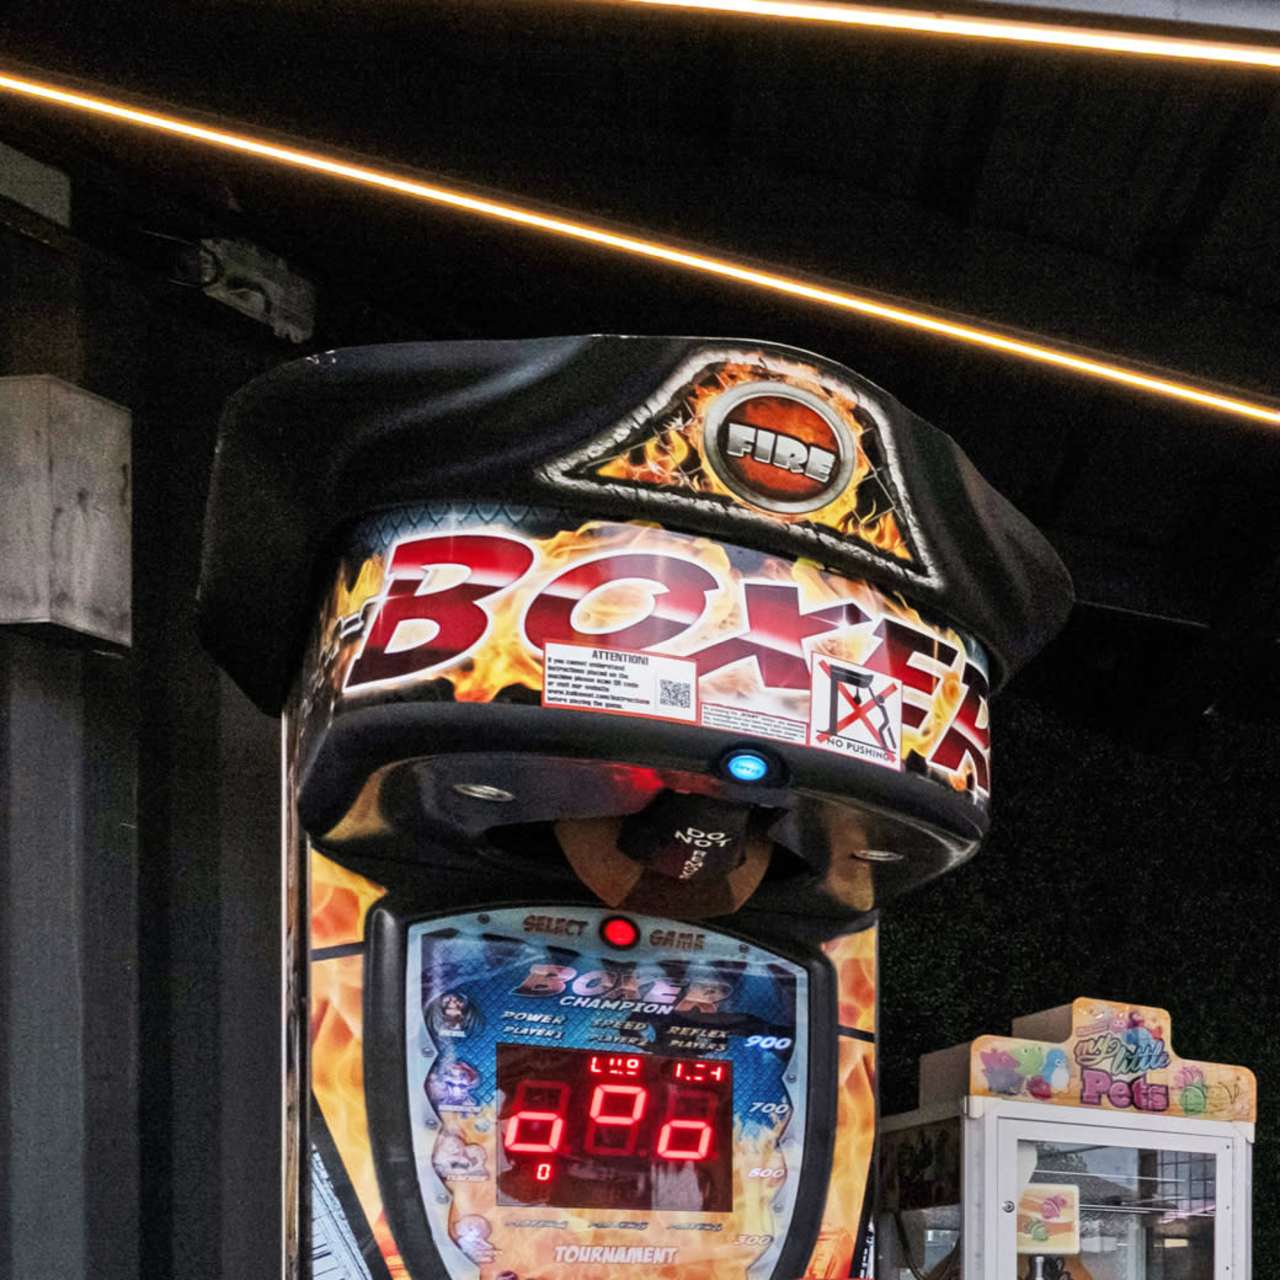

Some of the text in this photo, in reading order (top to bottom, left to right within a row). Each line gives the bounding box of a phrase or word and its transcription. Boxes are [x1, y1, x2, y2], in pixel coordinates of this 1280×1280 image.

[727, 421, 838, 485] FIRE
[592, 650, 649, 665] ATTENTION!
[846, 742, 891, 761] PUSHING
[523, 914, 706, 950] SELECT GAME
[510, 963, 733, 1014] BOXER
[559, 995, 674, 1016] CHAMPION
[500, 1010, 731, 1040] POWER SPEED REFLEX
[745, 1034, 792, 1051] 900
[1111, 1039, 1171, 1076] little
[1080, 1068, 1169, 1112] Pets
[749, 1102, 791, 1115] 700
[733, 1234, 773, 1246] 300
[554, 1245, 679, 1265] TOURNAMENT
